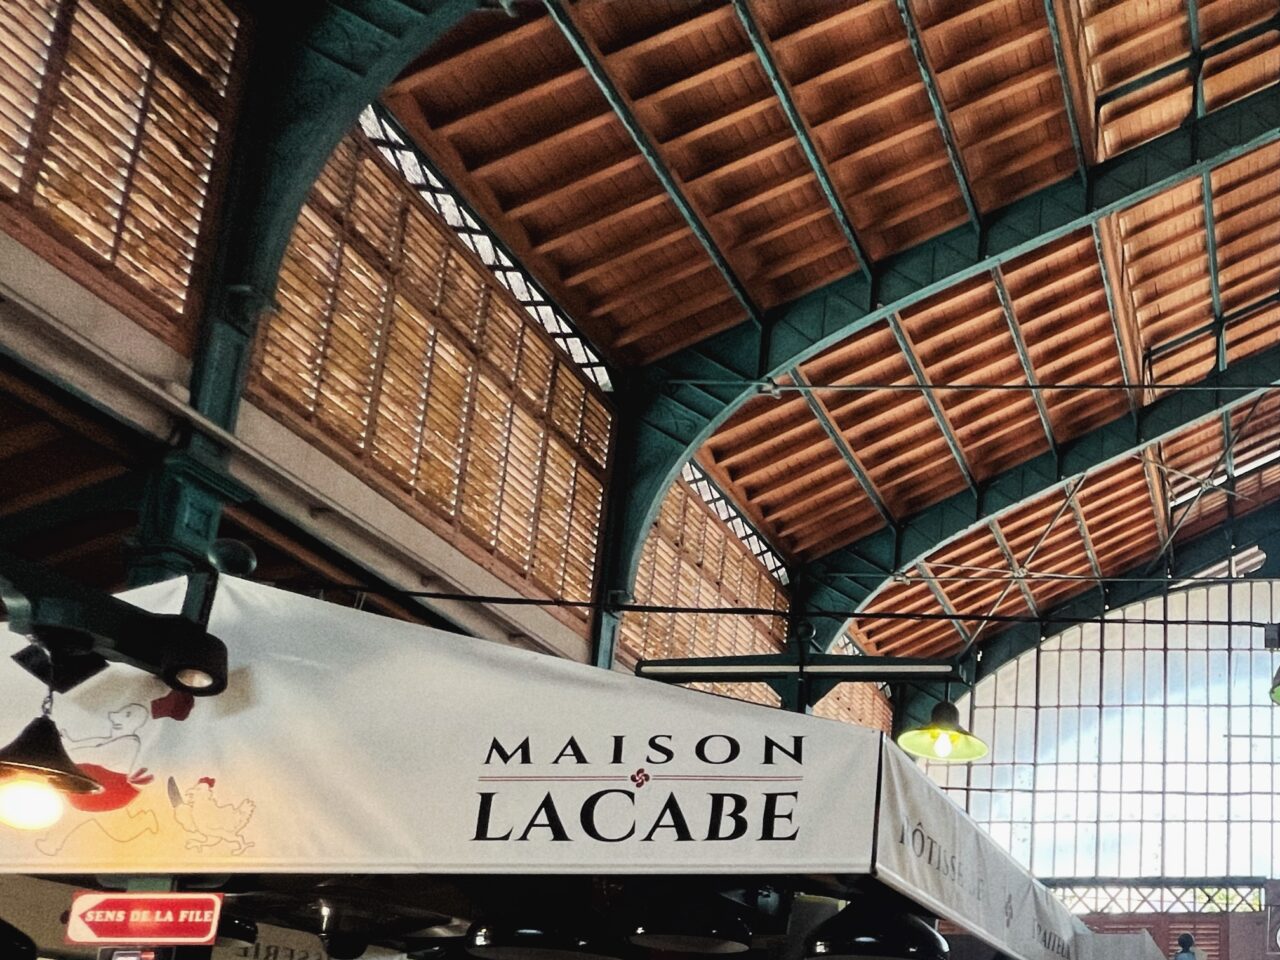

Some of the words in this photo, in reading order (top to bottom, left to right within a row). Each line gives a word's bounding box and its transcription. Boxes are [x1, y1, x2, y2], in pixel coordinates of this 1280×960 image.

[483, 734, 806, 765] MAISON
[468, 789, 800, 842] LACABE
[85, 910, 126, 922] SENS
[130, 910, 151, 922] DE
[154, 910, 174, 922] LA
[178, 910, 214, 922] FILE
